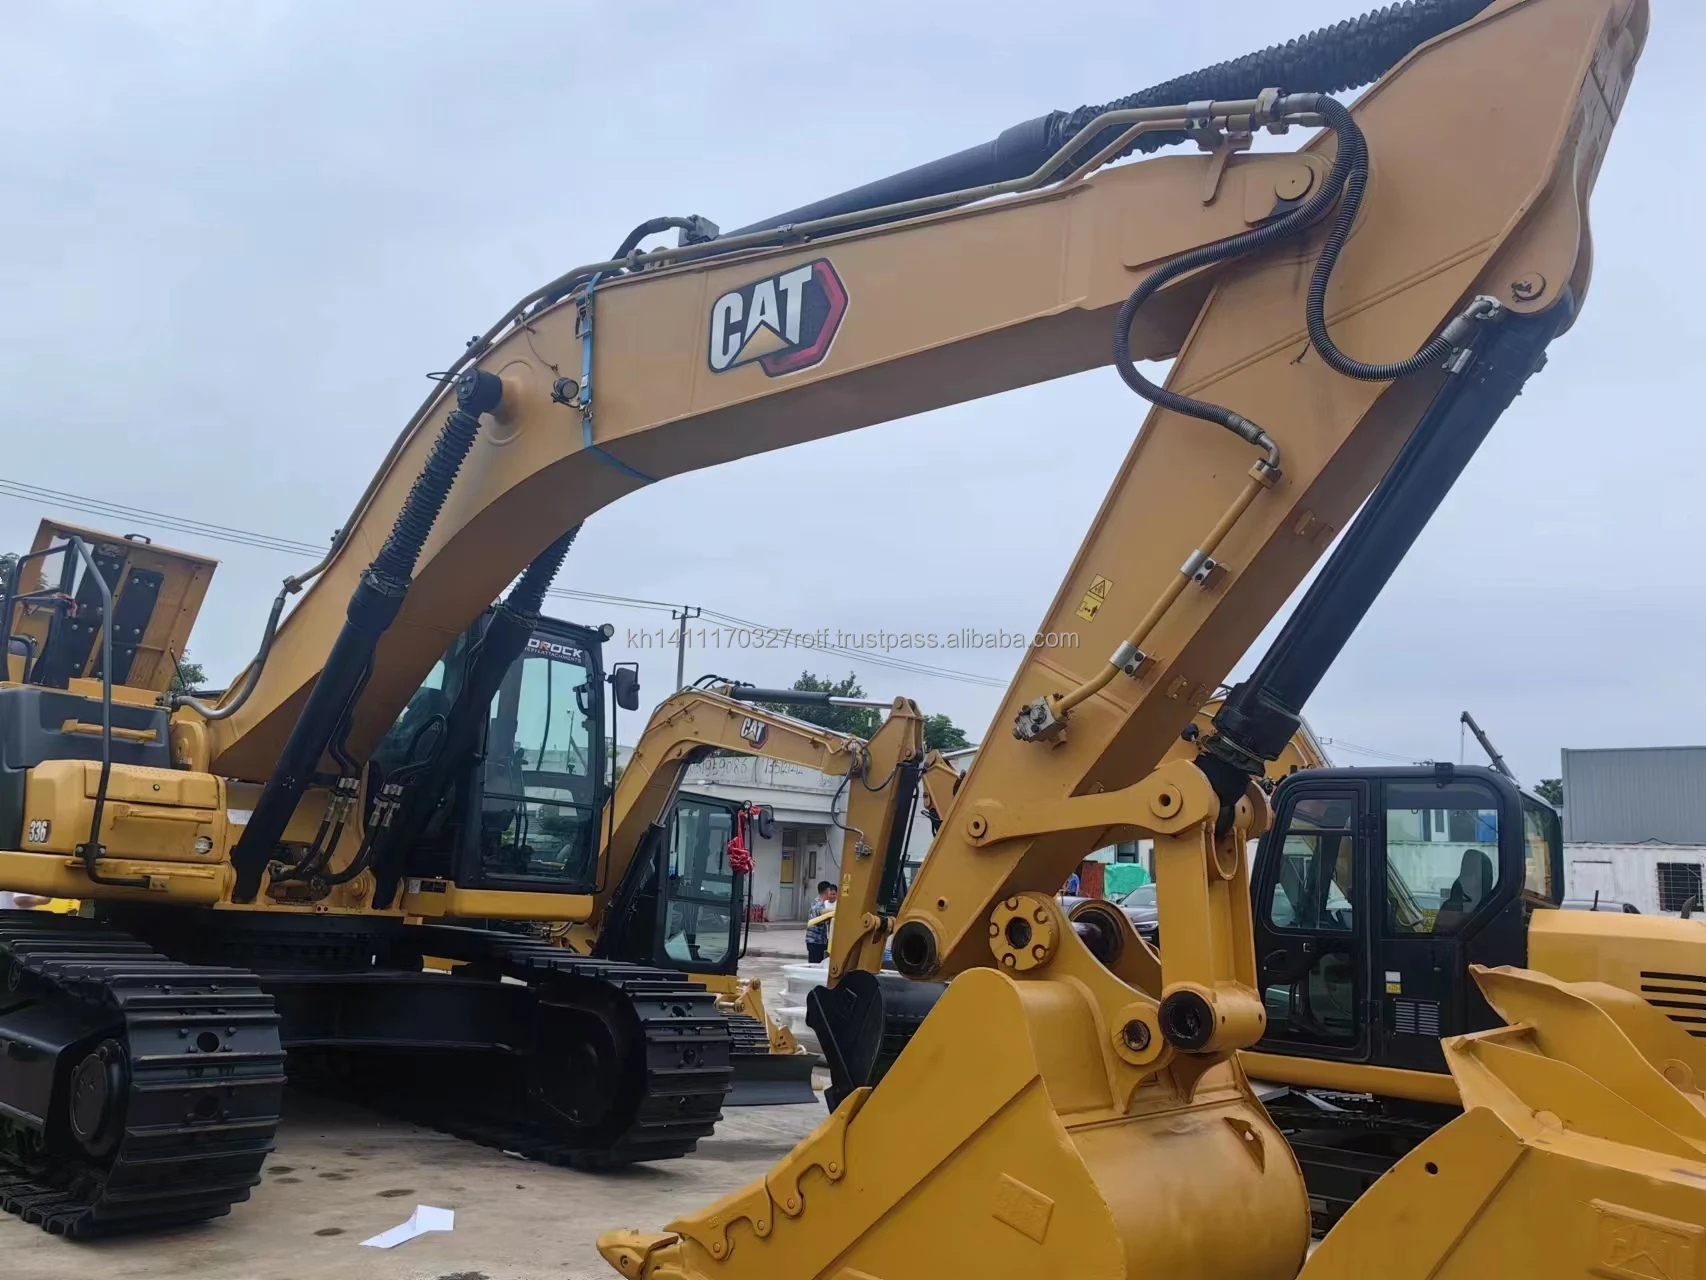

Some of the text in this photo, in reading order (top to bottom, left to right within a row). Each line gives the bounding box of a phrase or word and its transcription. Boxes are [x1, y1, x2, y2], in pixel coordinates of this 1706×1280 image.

[710, 264, 813, 370] CAT
[527, 638, 583, 658] DROCK
[741, 717, 765, 742] CAT
[28, 820, 48, 842] 336
